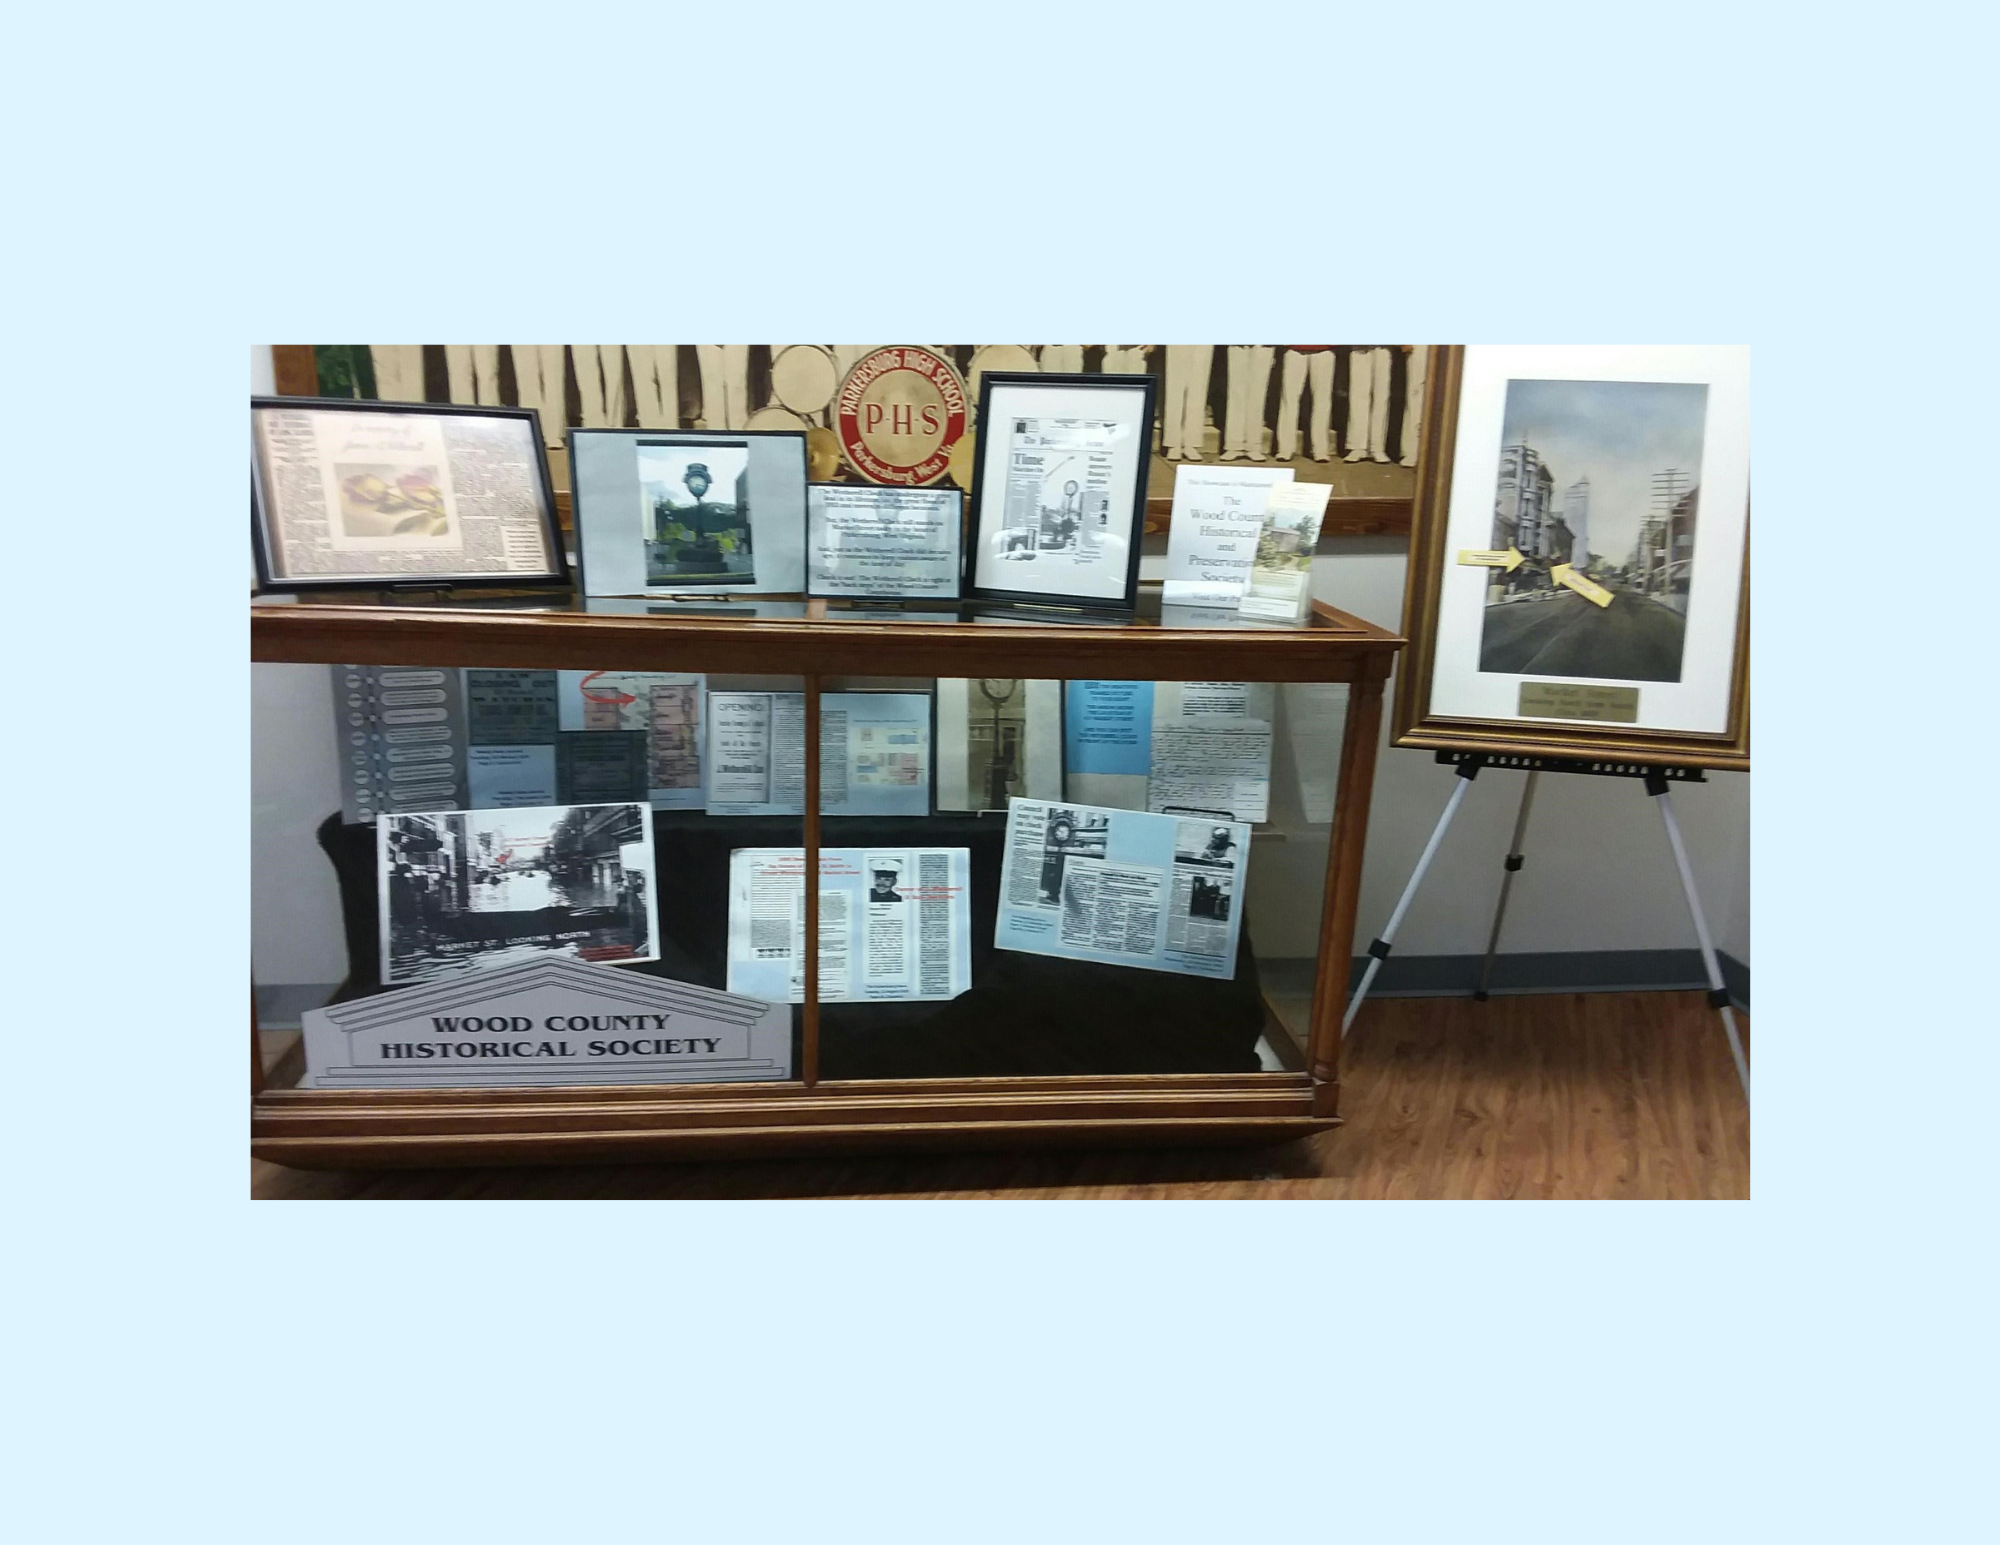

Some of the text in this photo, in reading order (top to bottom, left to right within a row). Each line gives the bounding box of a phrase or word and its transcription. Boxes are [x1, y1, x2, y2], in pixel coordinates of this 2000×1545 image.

[840, 350, 965, 418] PARKERSBURG HIGH SCHOOL
[849, 440, 917, 485] Parkersburg
[1012, 453, 1046, 466] Time
[1223, 496, 1242, 506] The
[1190, 508, 1225, 521] Wood
[1199, 525, 1258, 538] Historical
[1216, 542, 1237, 551] and
[435, 941, 480, 952] MARKET
[505, 934, 552, 945] LOOKING
[555, 931, 592, 941] NORTH
[431, 1014, 671, 1033] WOOD COUNTY
[380, 1037, 723, 1059] HISTORICAL SOCIETY
